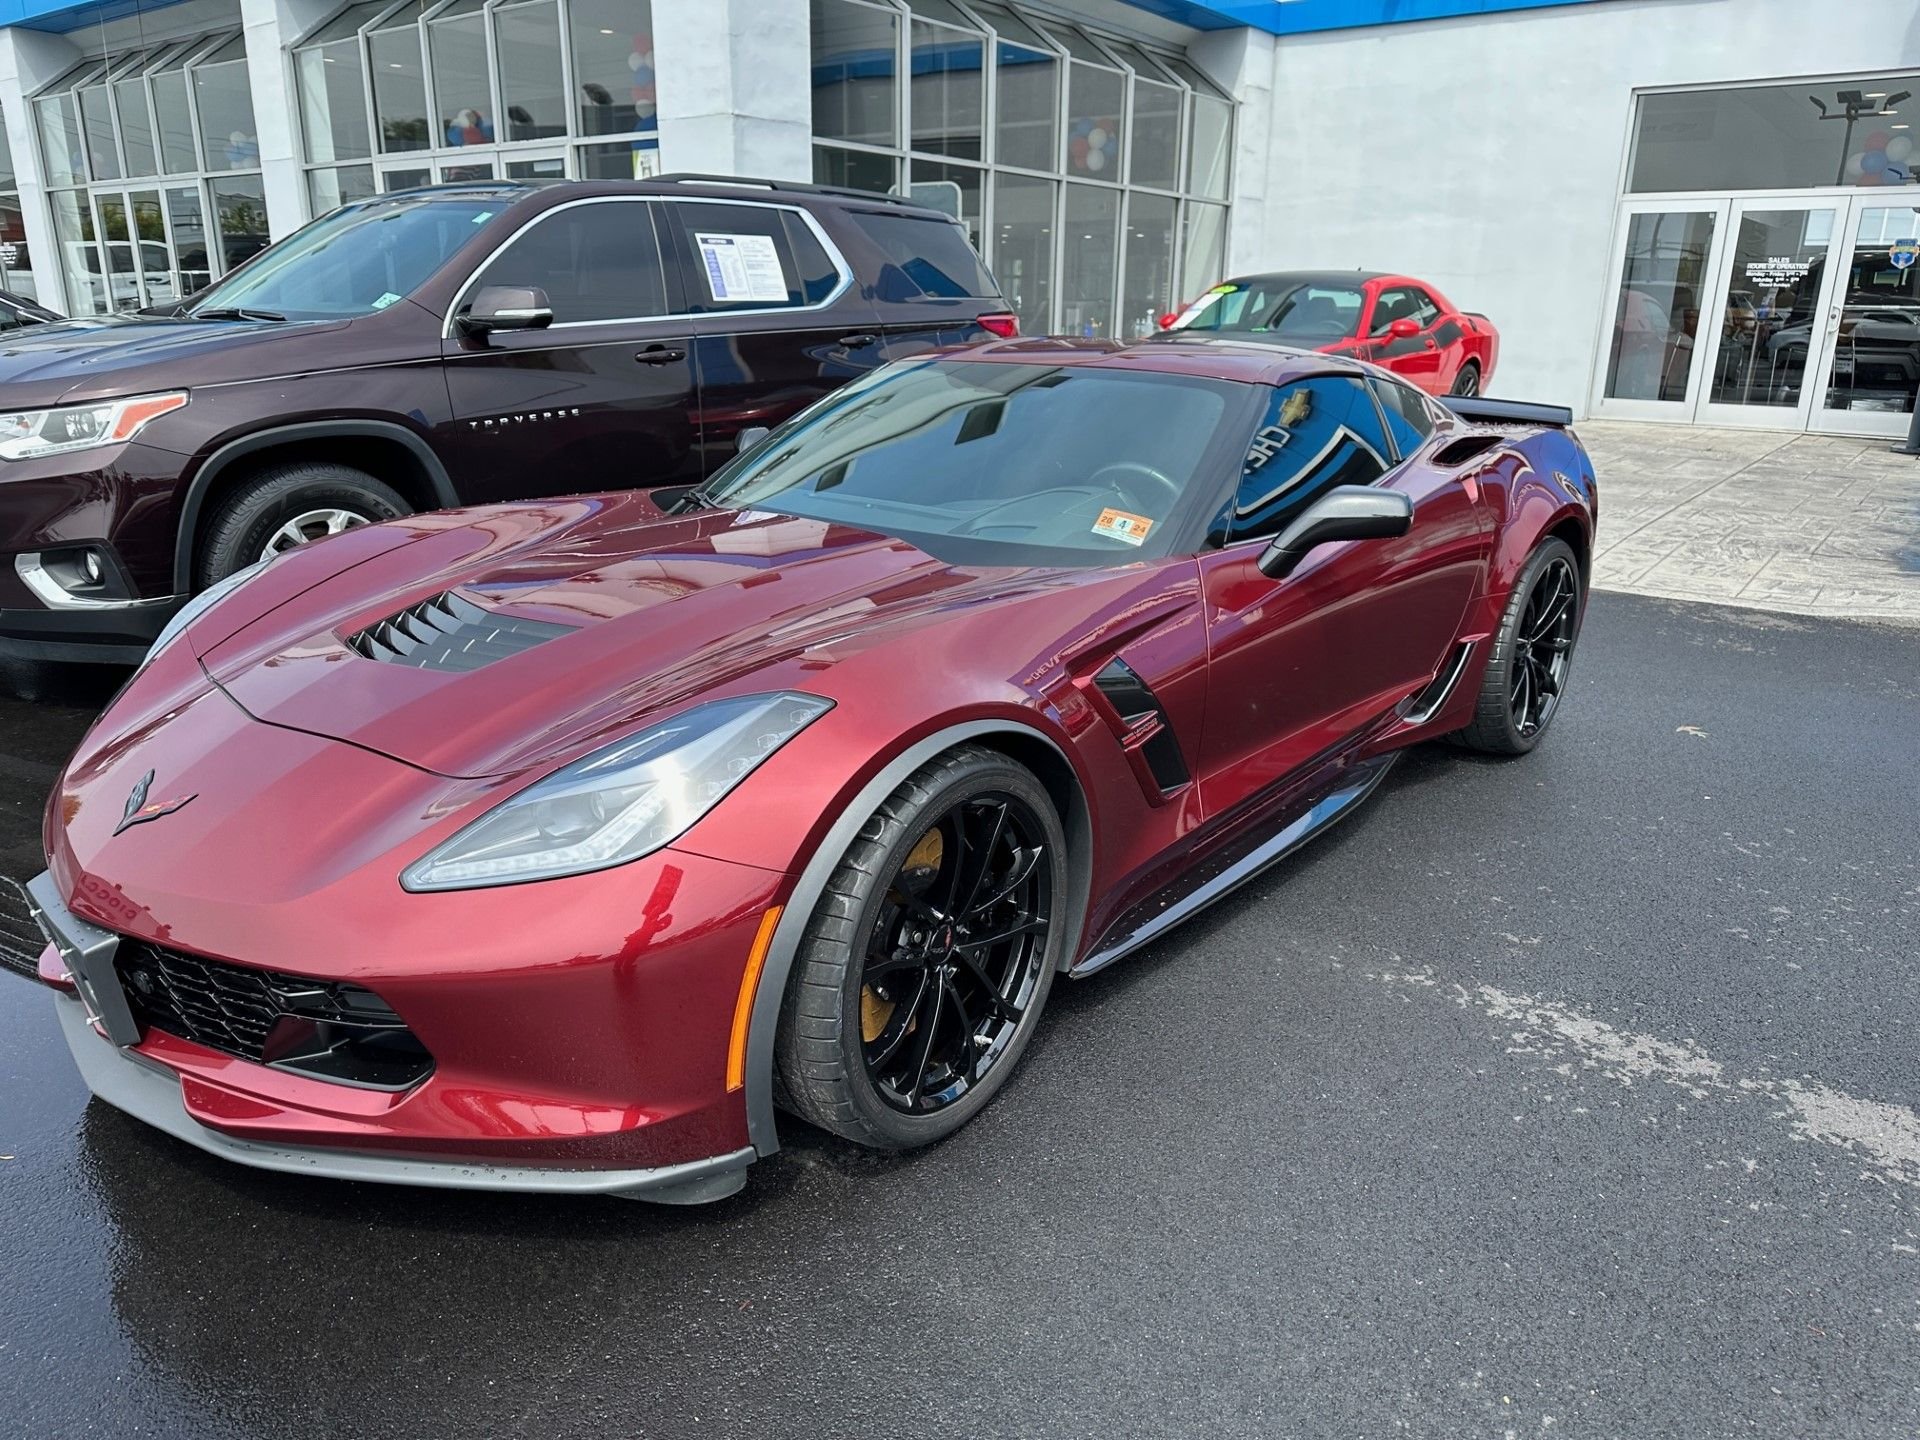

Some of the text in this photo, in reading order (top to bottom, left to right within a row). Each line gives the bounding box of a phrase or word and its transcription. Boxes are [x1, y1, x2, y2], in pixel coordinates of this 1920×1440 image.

[469, 408, 579, 429] TRAVERSE
[1101, 515, 1147, 533] 20 4 24
